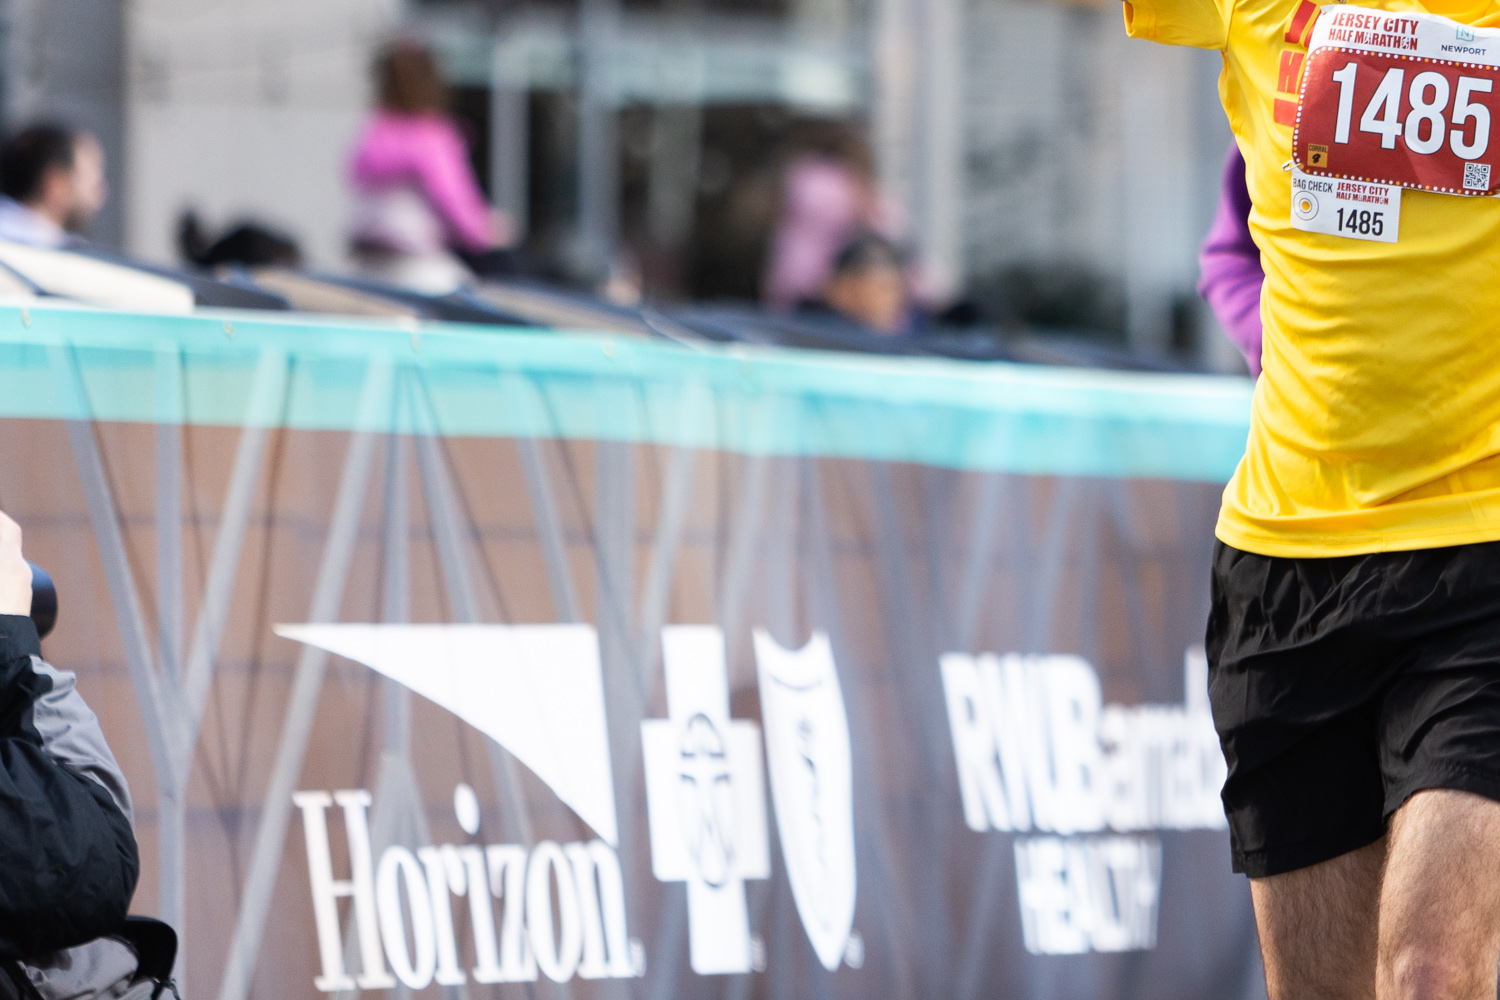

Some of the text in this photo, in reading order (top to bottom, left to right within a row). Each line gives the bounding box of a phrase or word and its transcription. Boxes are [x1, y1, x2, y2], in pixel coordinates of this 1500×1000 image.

[1331, 12, 1420, 36] JERSEY CITY
[1328, 27, 1419, 51] HALF MARATHON
[1440, 43, 1487, 56] NEWPORT
[1332, 62, 1493, 161] 1485
[1308, 144, 1328, 154] CORRAL
[1292, 177, 1334, 194] BAG CHECK
[1336, 182, 1390, 197] JERSEY CITY
[1335, 191, 1389, 206] HALF MARATHON
[1336, 207, 1384, 237] 1485
[292, 782, 633, 992] Horizon
[1013, 836, 1162, 956] HEALTH
